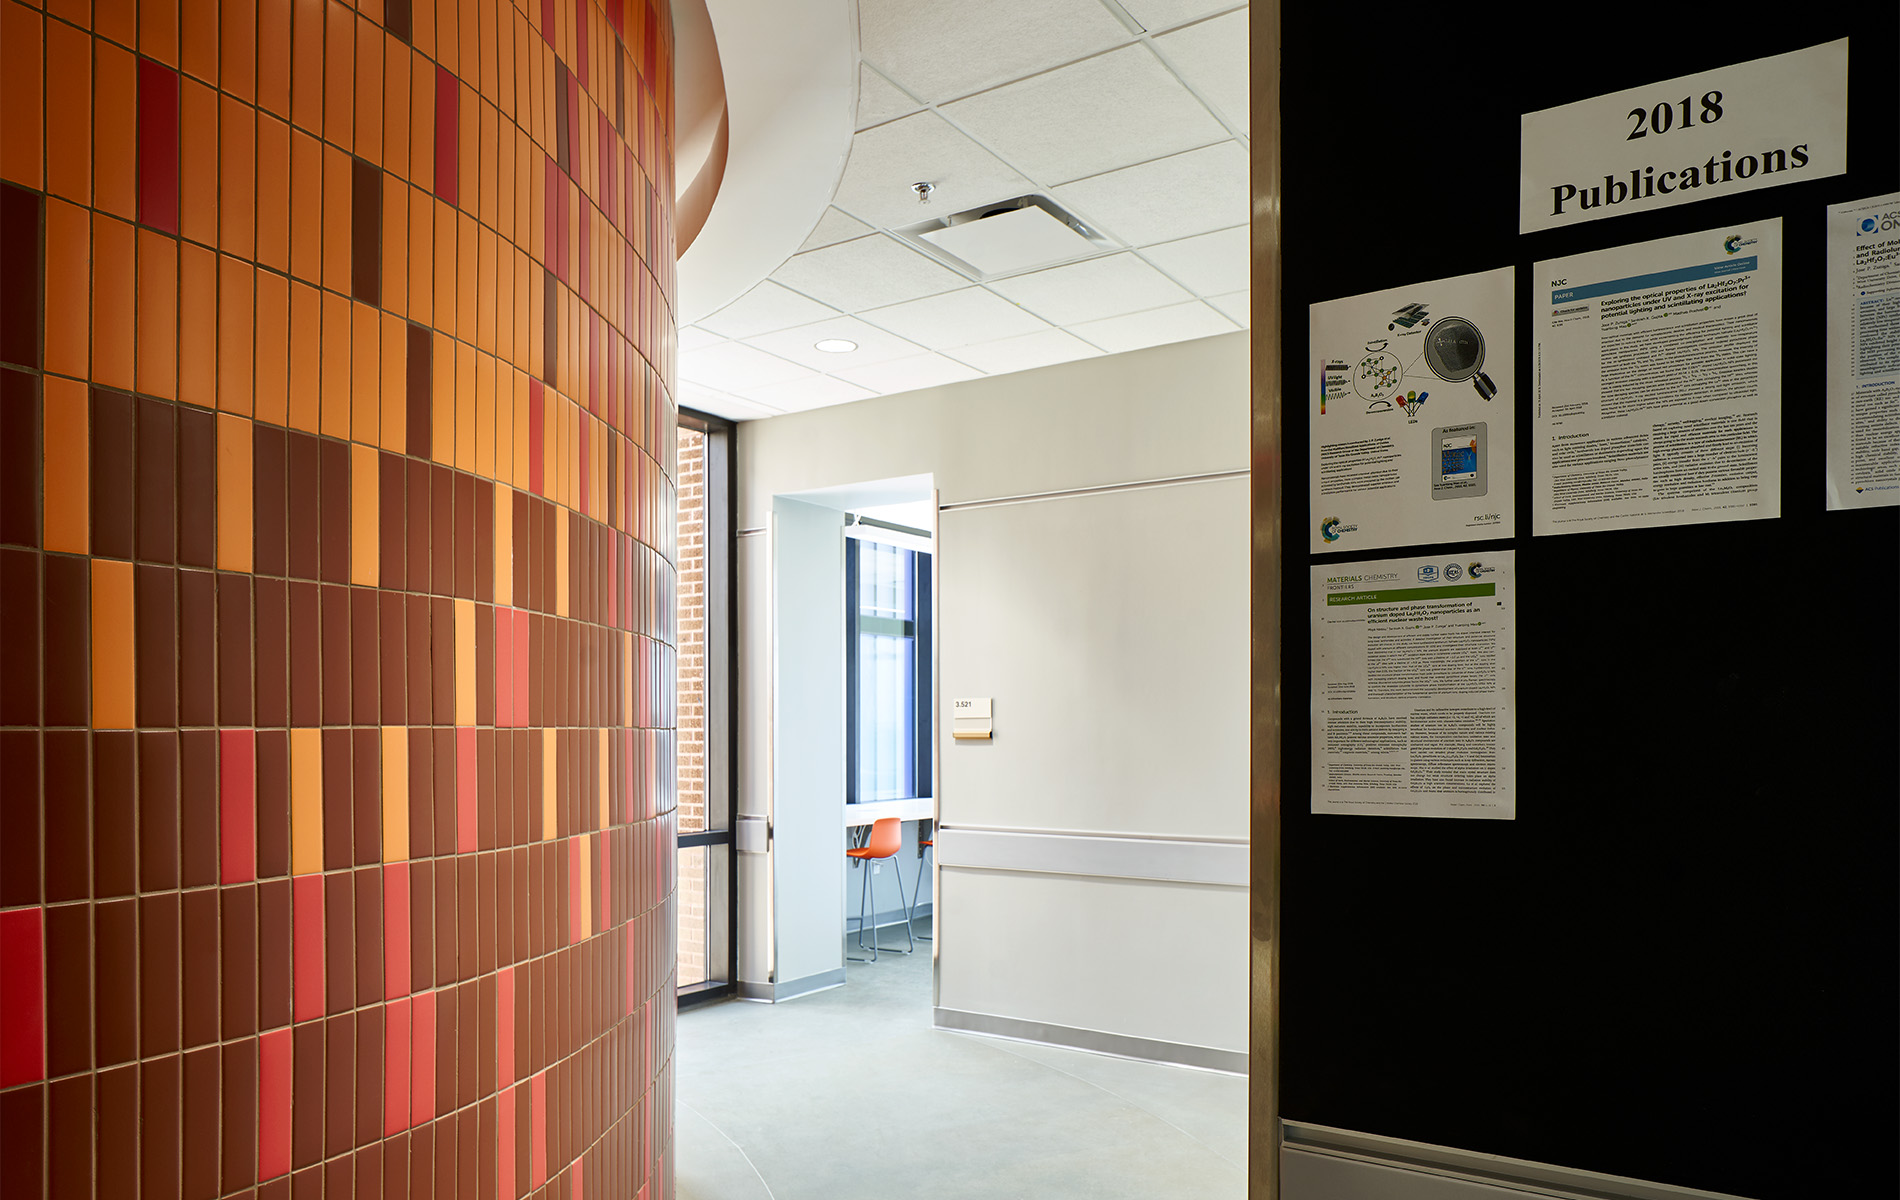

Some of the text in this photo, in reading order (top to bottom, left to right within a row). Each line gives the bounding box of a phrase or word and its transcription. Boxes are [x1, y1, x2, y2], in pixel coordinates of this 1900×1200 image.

[1626, 90, 1724, 141] 2018
[1550, 143, 1809, 216] Publications
[1551, 278, 1567, 287] NJC
[1601, 298, 1629, 306] Exploring
[1642, 291, 1663, 299] optical
[1665, 286, 1696, 296] properties
[1601, 302, 1641, 312] nanoparticles
[1705, 286, 1737, 296] excitation
[1601, 310, 1628, 320] potential
[1629, 306, 1653, 315] lighting
[1667, 299, 1703, 308] scintillating
